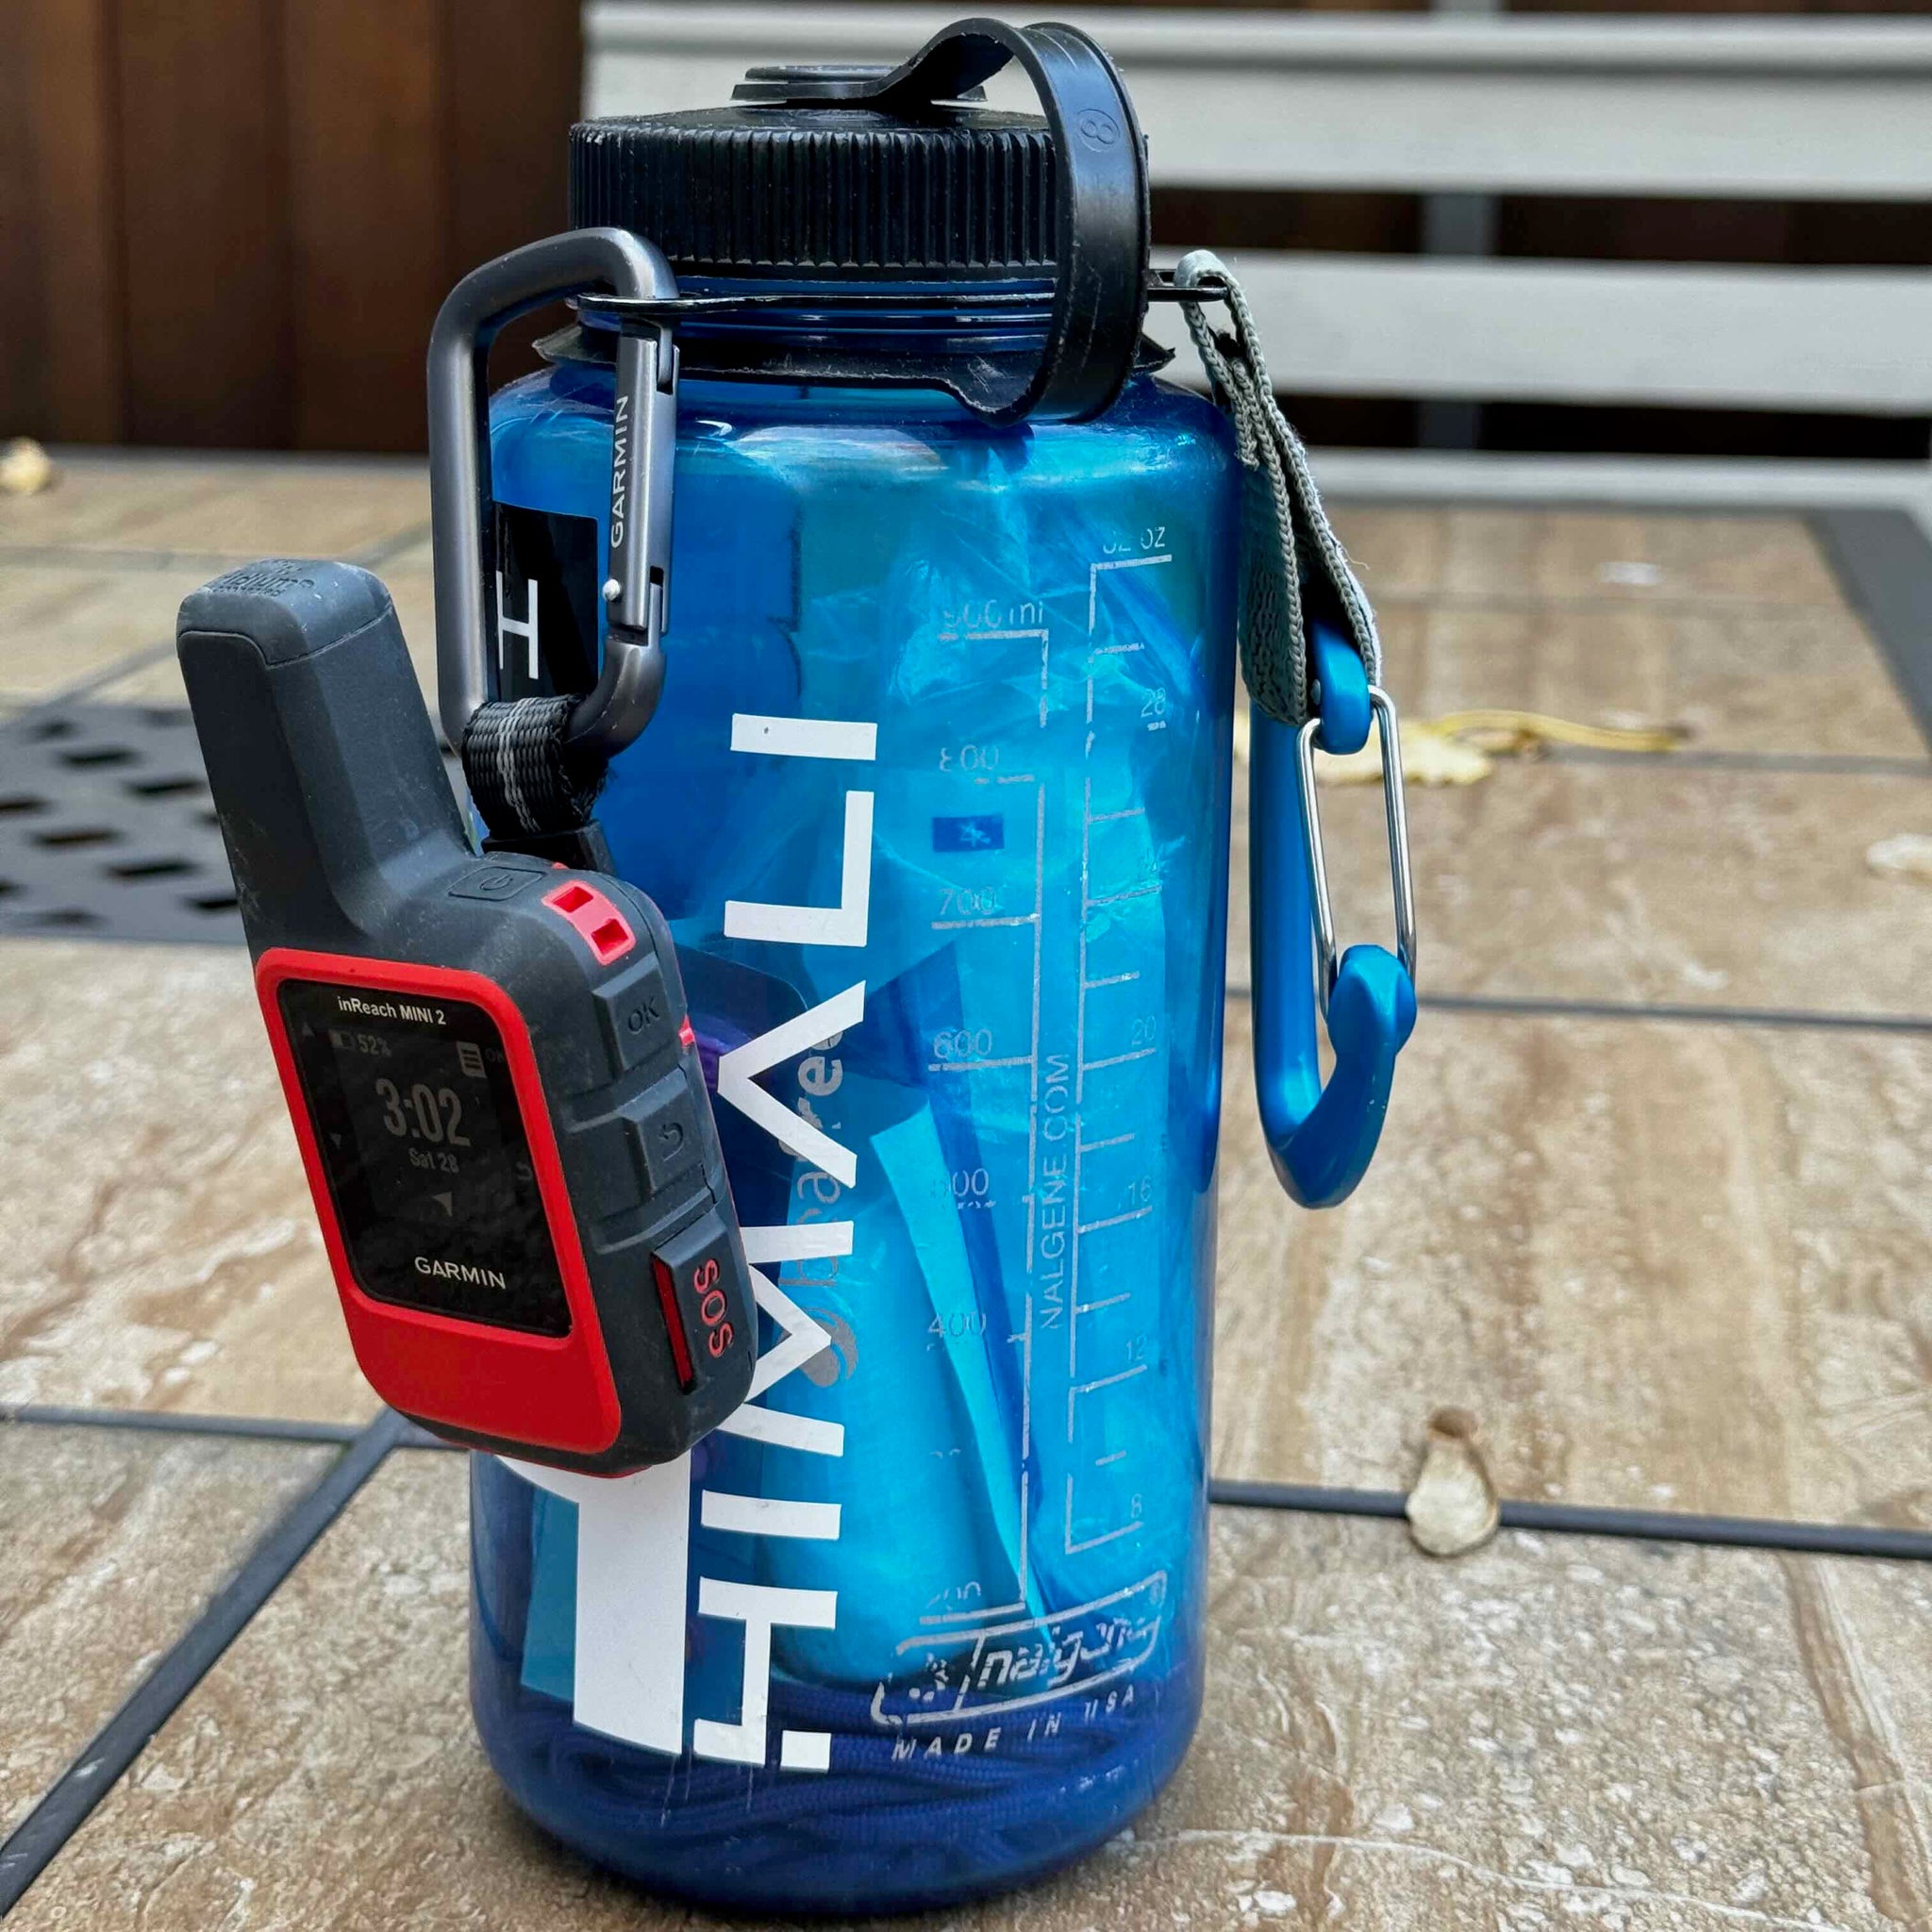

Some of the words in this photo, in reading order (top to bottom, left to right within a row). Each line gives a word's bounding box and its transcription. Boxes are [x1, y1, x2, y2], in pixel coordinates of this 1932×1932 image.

[610, 395, 629, 549] GARMIN
[495, 570, 539, 679] H
[1141, 688, 1166, 718] 28
[940, 887, 997, 915] 700
[339, 996, 396, 1018] inReach
[400, 1008, 433, 1024] MINI
[436, 1009, 446, 1025] 2
[627, 996, 659, 1034] OK
[358, 1034, 391, 1057] 52%
[933, 1029, 991, 1058] 600
[1132, 1015, 1156, 1045] 20
[375, 1078, 471, 1147] 3:02
[408, 1148, 433, 1169] Sat
[437, 1152, 459, 1174] 28
[415, 1257, 506, 1290] GARMIN
[692, 1257, 733, 1358] SOS
[891, 1727, 1001, 1760] MADE
[1028, 1711, 1061, 1741] IN
[1085, 1684, 1133, 1720] USA
